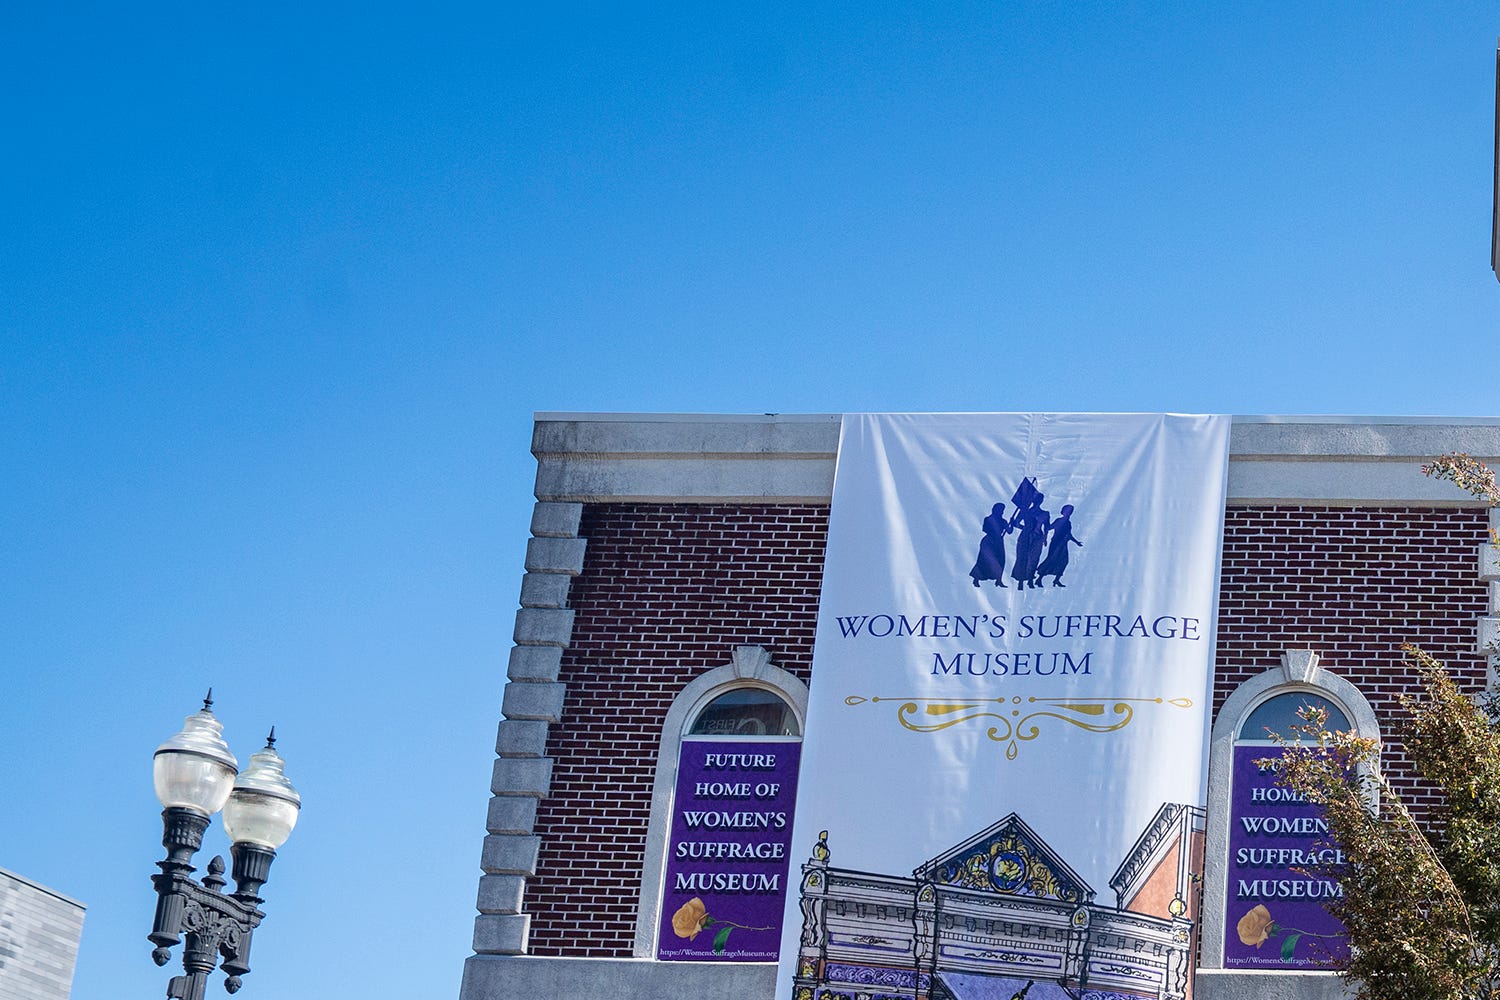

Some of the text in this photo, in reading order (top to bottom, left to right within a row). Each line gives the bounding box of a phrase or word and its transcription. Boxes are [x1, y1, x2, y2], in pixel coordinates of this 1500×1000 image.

[836, 614, 1201, 641] WOMEN'S SUFFRAGE
[930, 652, 1093, 676] MUSEUM
[704, 754, 776, 768] FUTURE
[694, 782, 780, 797] HOME OF
[683, 811, 786, 828] WOMEN'S
[1241, 817, 1329, 833] WOMEN
[676, 842, 785, 859] SUFFRAGE
[1237, 848, 1348, 865] SUFFRAGE
[674, 872, 780, 890] MUSEUM
[1237, 879, 1344, 897] MUSEUM
